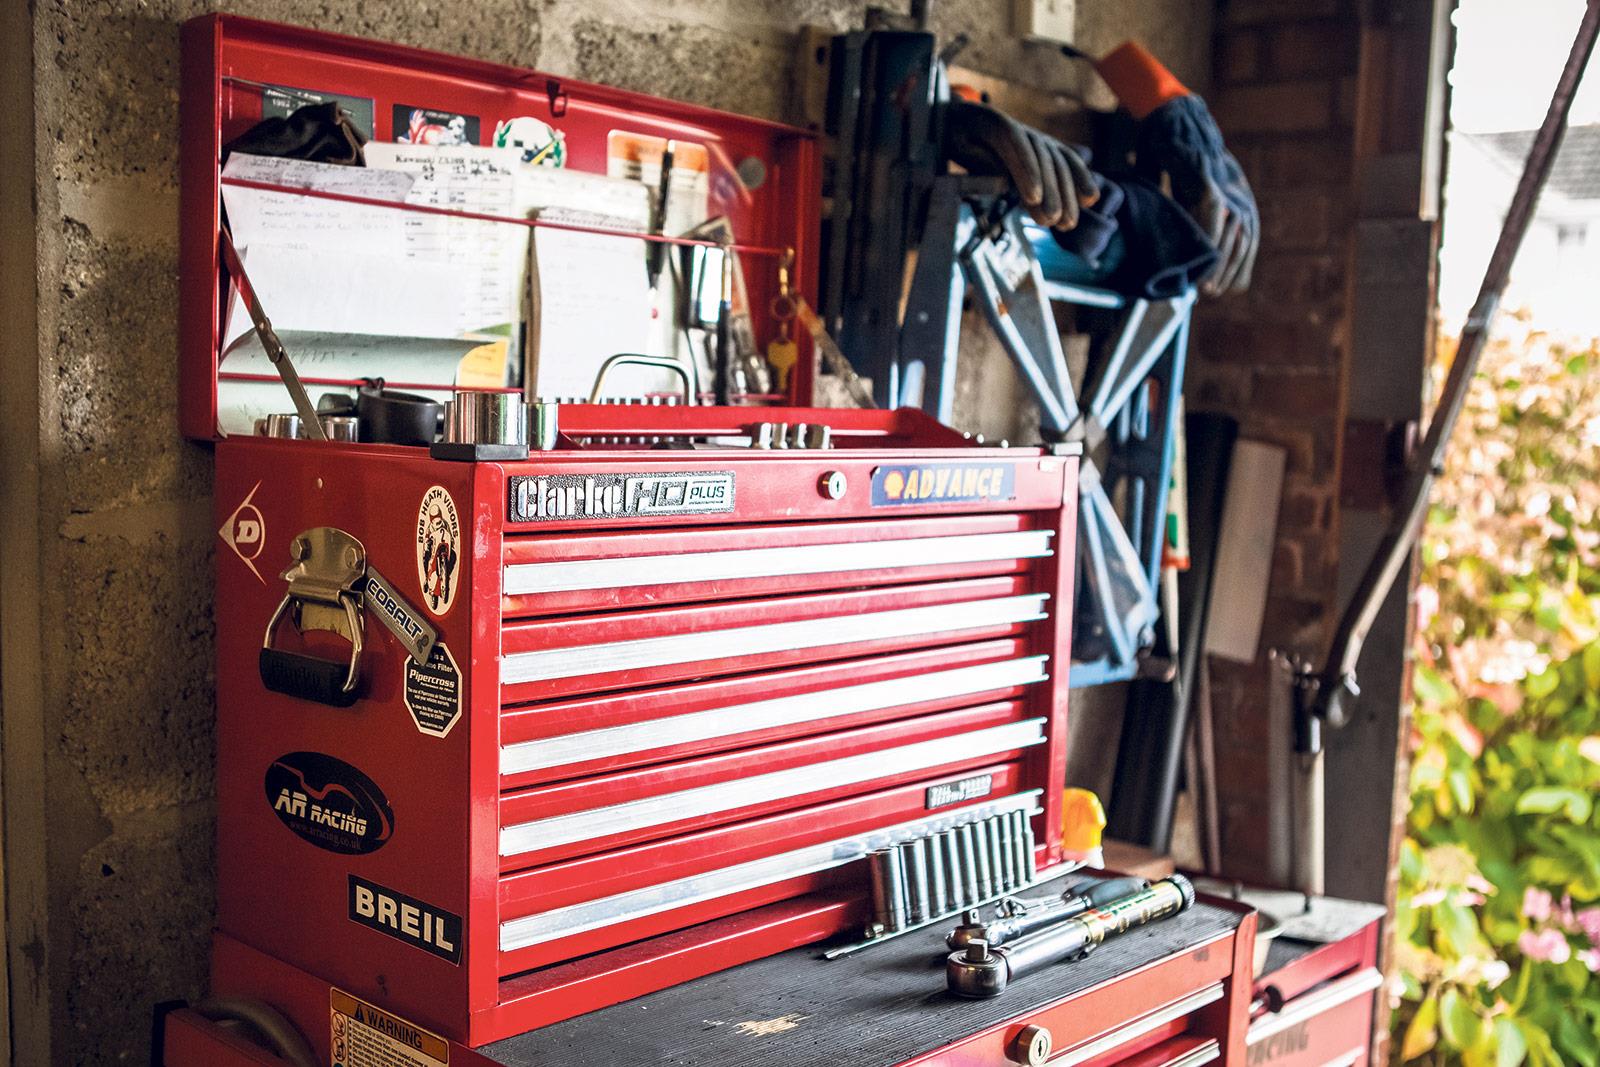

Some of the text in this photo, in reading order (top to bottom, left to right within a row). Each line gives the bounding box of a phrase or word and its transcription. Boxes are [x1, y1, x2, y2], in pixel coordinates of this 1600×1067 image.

[517, 478, 622, 517] Clarke
[689, 485, 725, 499] PLUS
[903, 467, 1004, 499] ADVANCE
[421, 489, 443, 516] HEATH
[443, 494, 459, 538] VISORS
[366, 577, 424, 641] COBALT
[409, 669, 455, 689] Pipercross
[274, 788, 367, 836] AR RACING
[356, 885, 454, 952] BREIL
[367, 1007, 423, 1050] WARNING
